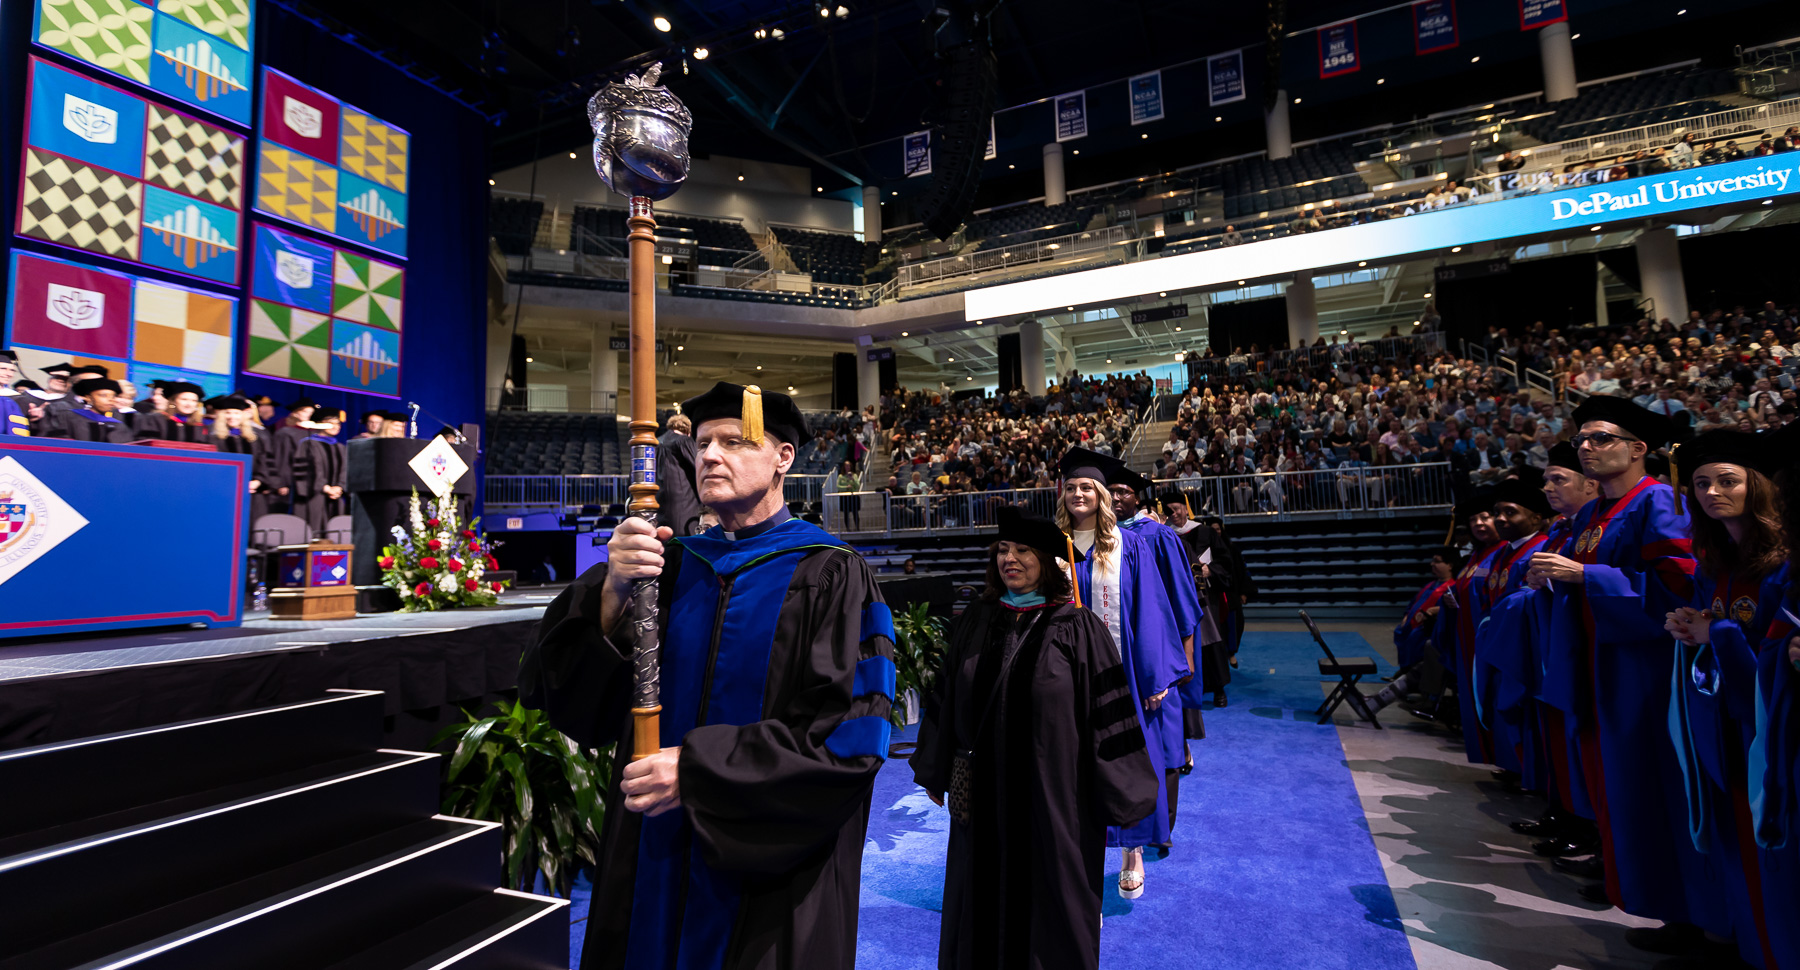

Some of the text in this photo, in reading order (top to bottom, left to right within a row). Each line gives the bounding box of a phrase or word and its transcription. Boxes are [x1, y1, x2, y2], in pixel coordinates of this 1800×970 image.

[1420, 15, 1449, 29] NCAA
[1330, 41, 1345, 51] NIT
[1323, 52, 1355, 69] 1945
[1214, 69, 1238, 81] NCAA
[1134, 89, 1157, 101] NCAA
[1060, 108, 1081, 120] NCAA
[908, 147, 927, 157] NCAA
[1551, 184, 1650, 221] DePaul
[1652, 166, 1792, 203] University
[1117, 209, 1131, 218] 223
[677, 247, 690, 255] 222
[1437, 262, 1508, 280] 123 124
[1133, 307, 1186, 323] 122 123
[611, 340, 626, 349] 120
